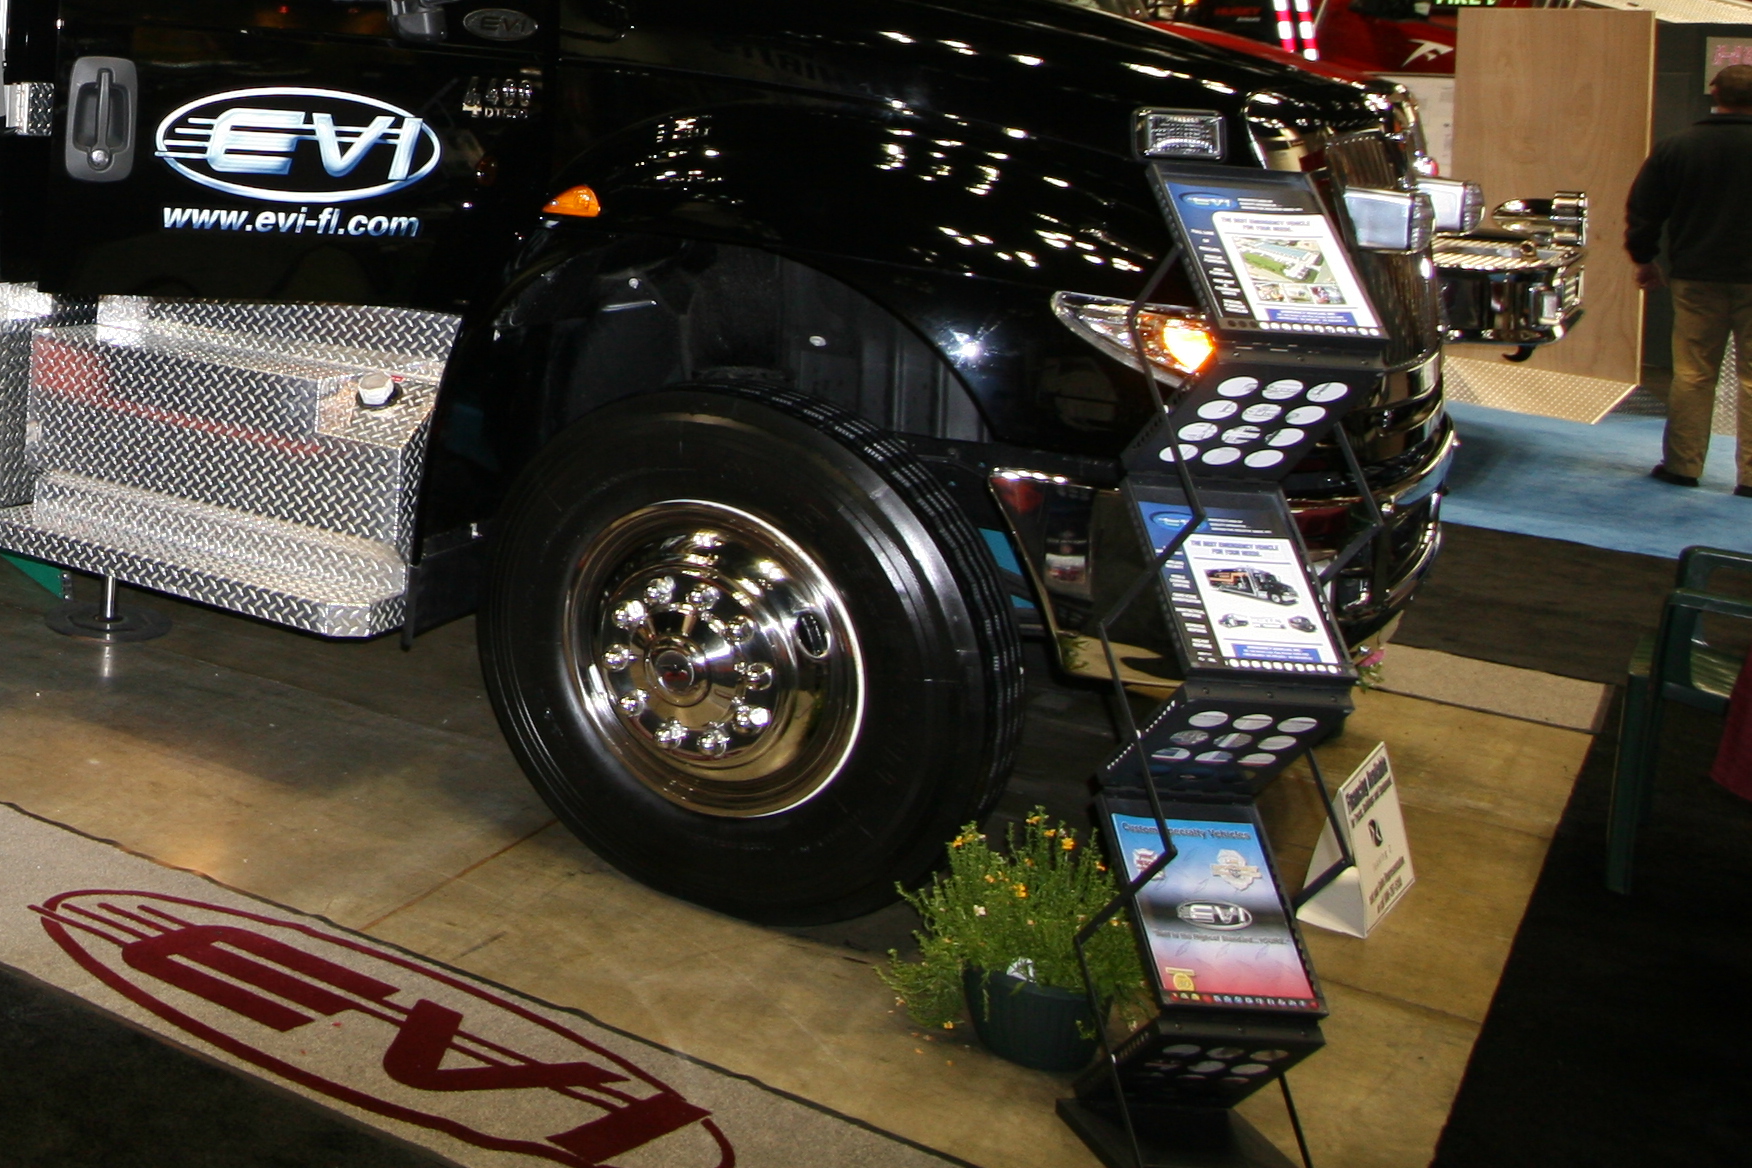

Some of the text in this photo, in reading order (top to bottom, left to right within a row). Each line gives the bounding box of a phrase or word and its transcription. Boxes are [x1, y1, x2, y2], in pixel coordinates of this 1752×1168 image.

[155, 107, 423, 182] EVI
[162, 205, 420, 238] www.evi-fl.com
[1188, 904, 1247, 924] EVI
[29, 905, 711, 1164] EVI
